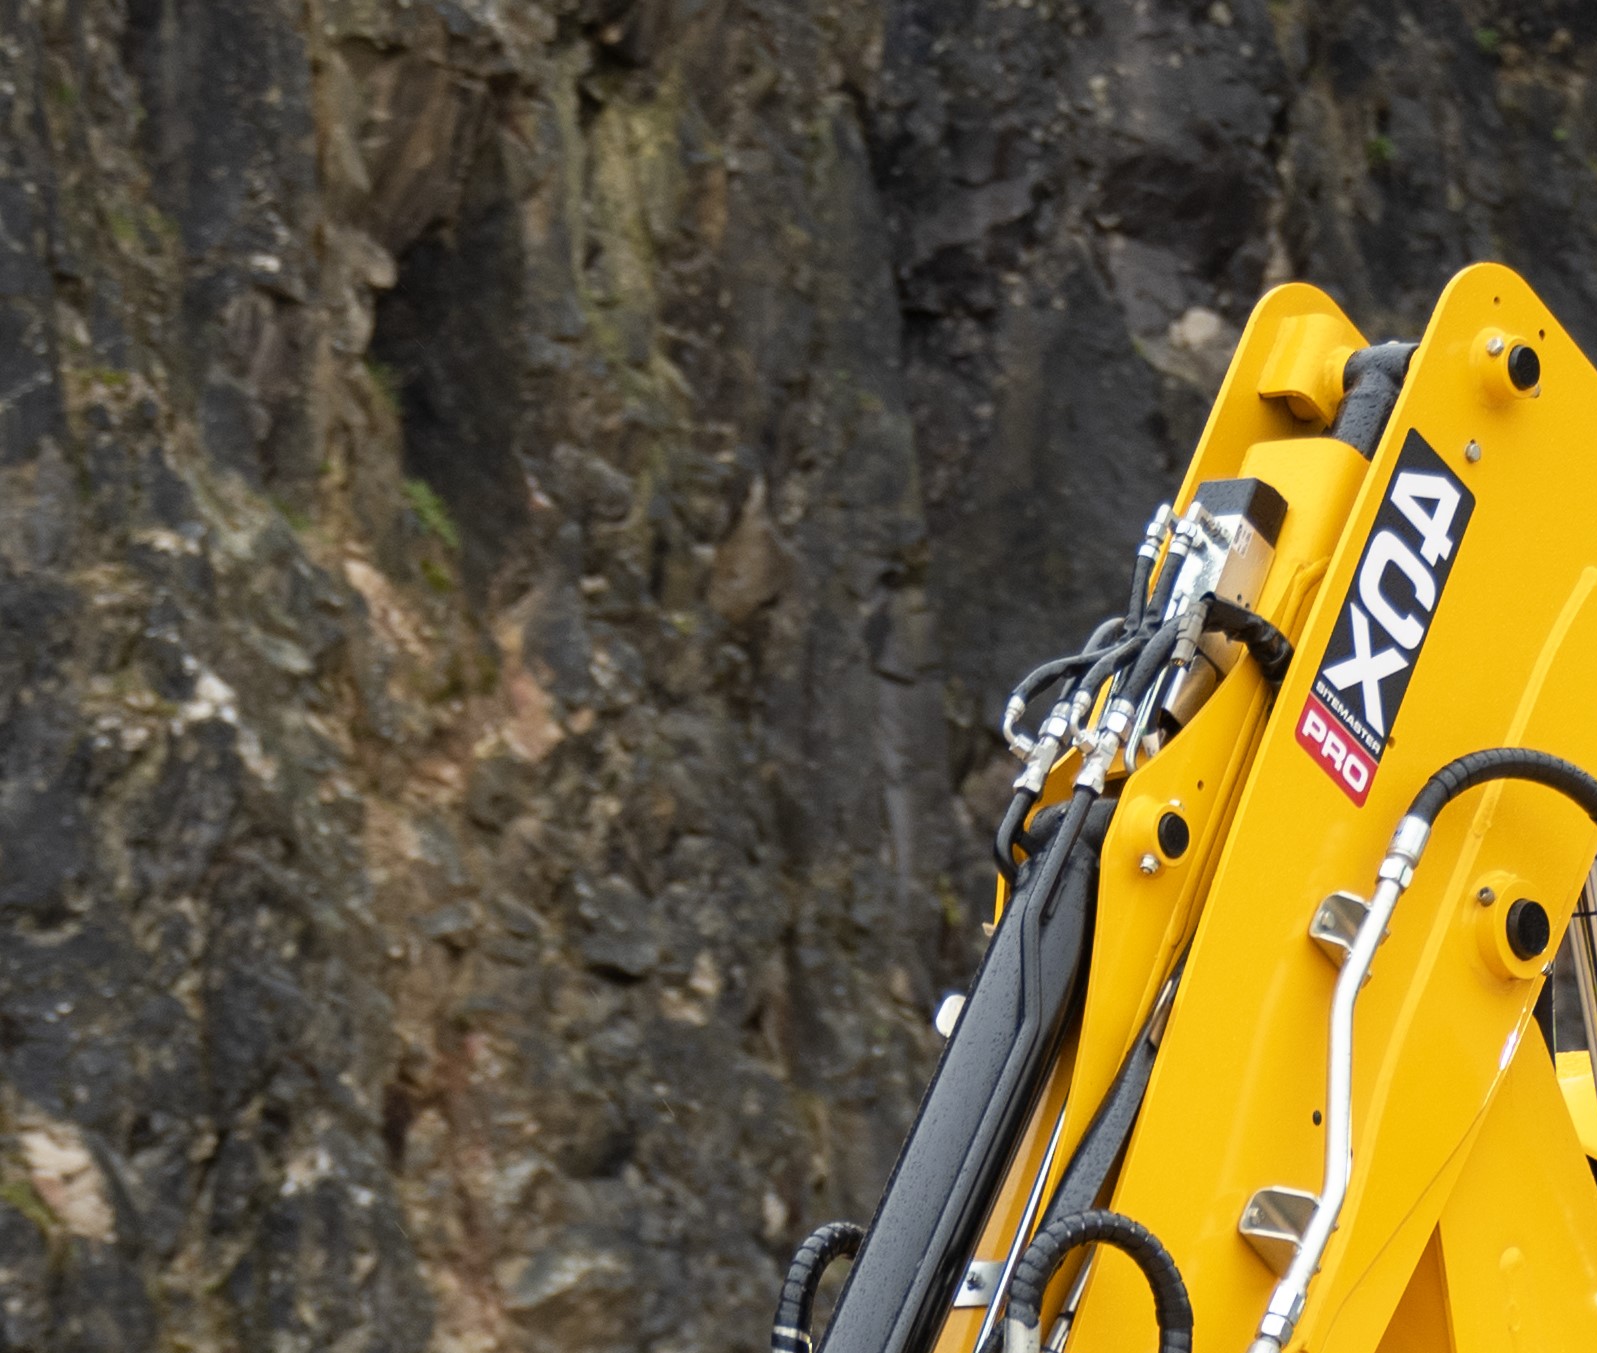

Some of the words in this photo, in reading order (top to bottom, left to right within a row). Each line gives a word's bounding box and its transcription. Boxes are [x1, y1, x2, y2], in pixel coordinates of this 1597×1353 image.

[1321, 471, 1461, 738] 4CX
[1301, 709, 1369, 793] PRO
[1316, 680, 1381, 755] SITEMASTER
